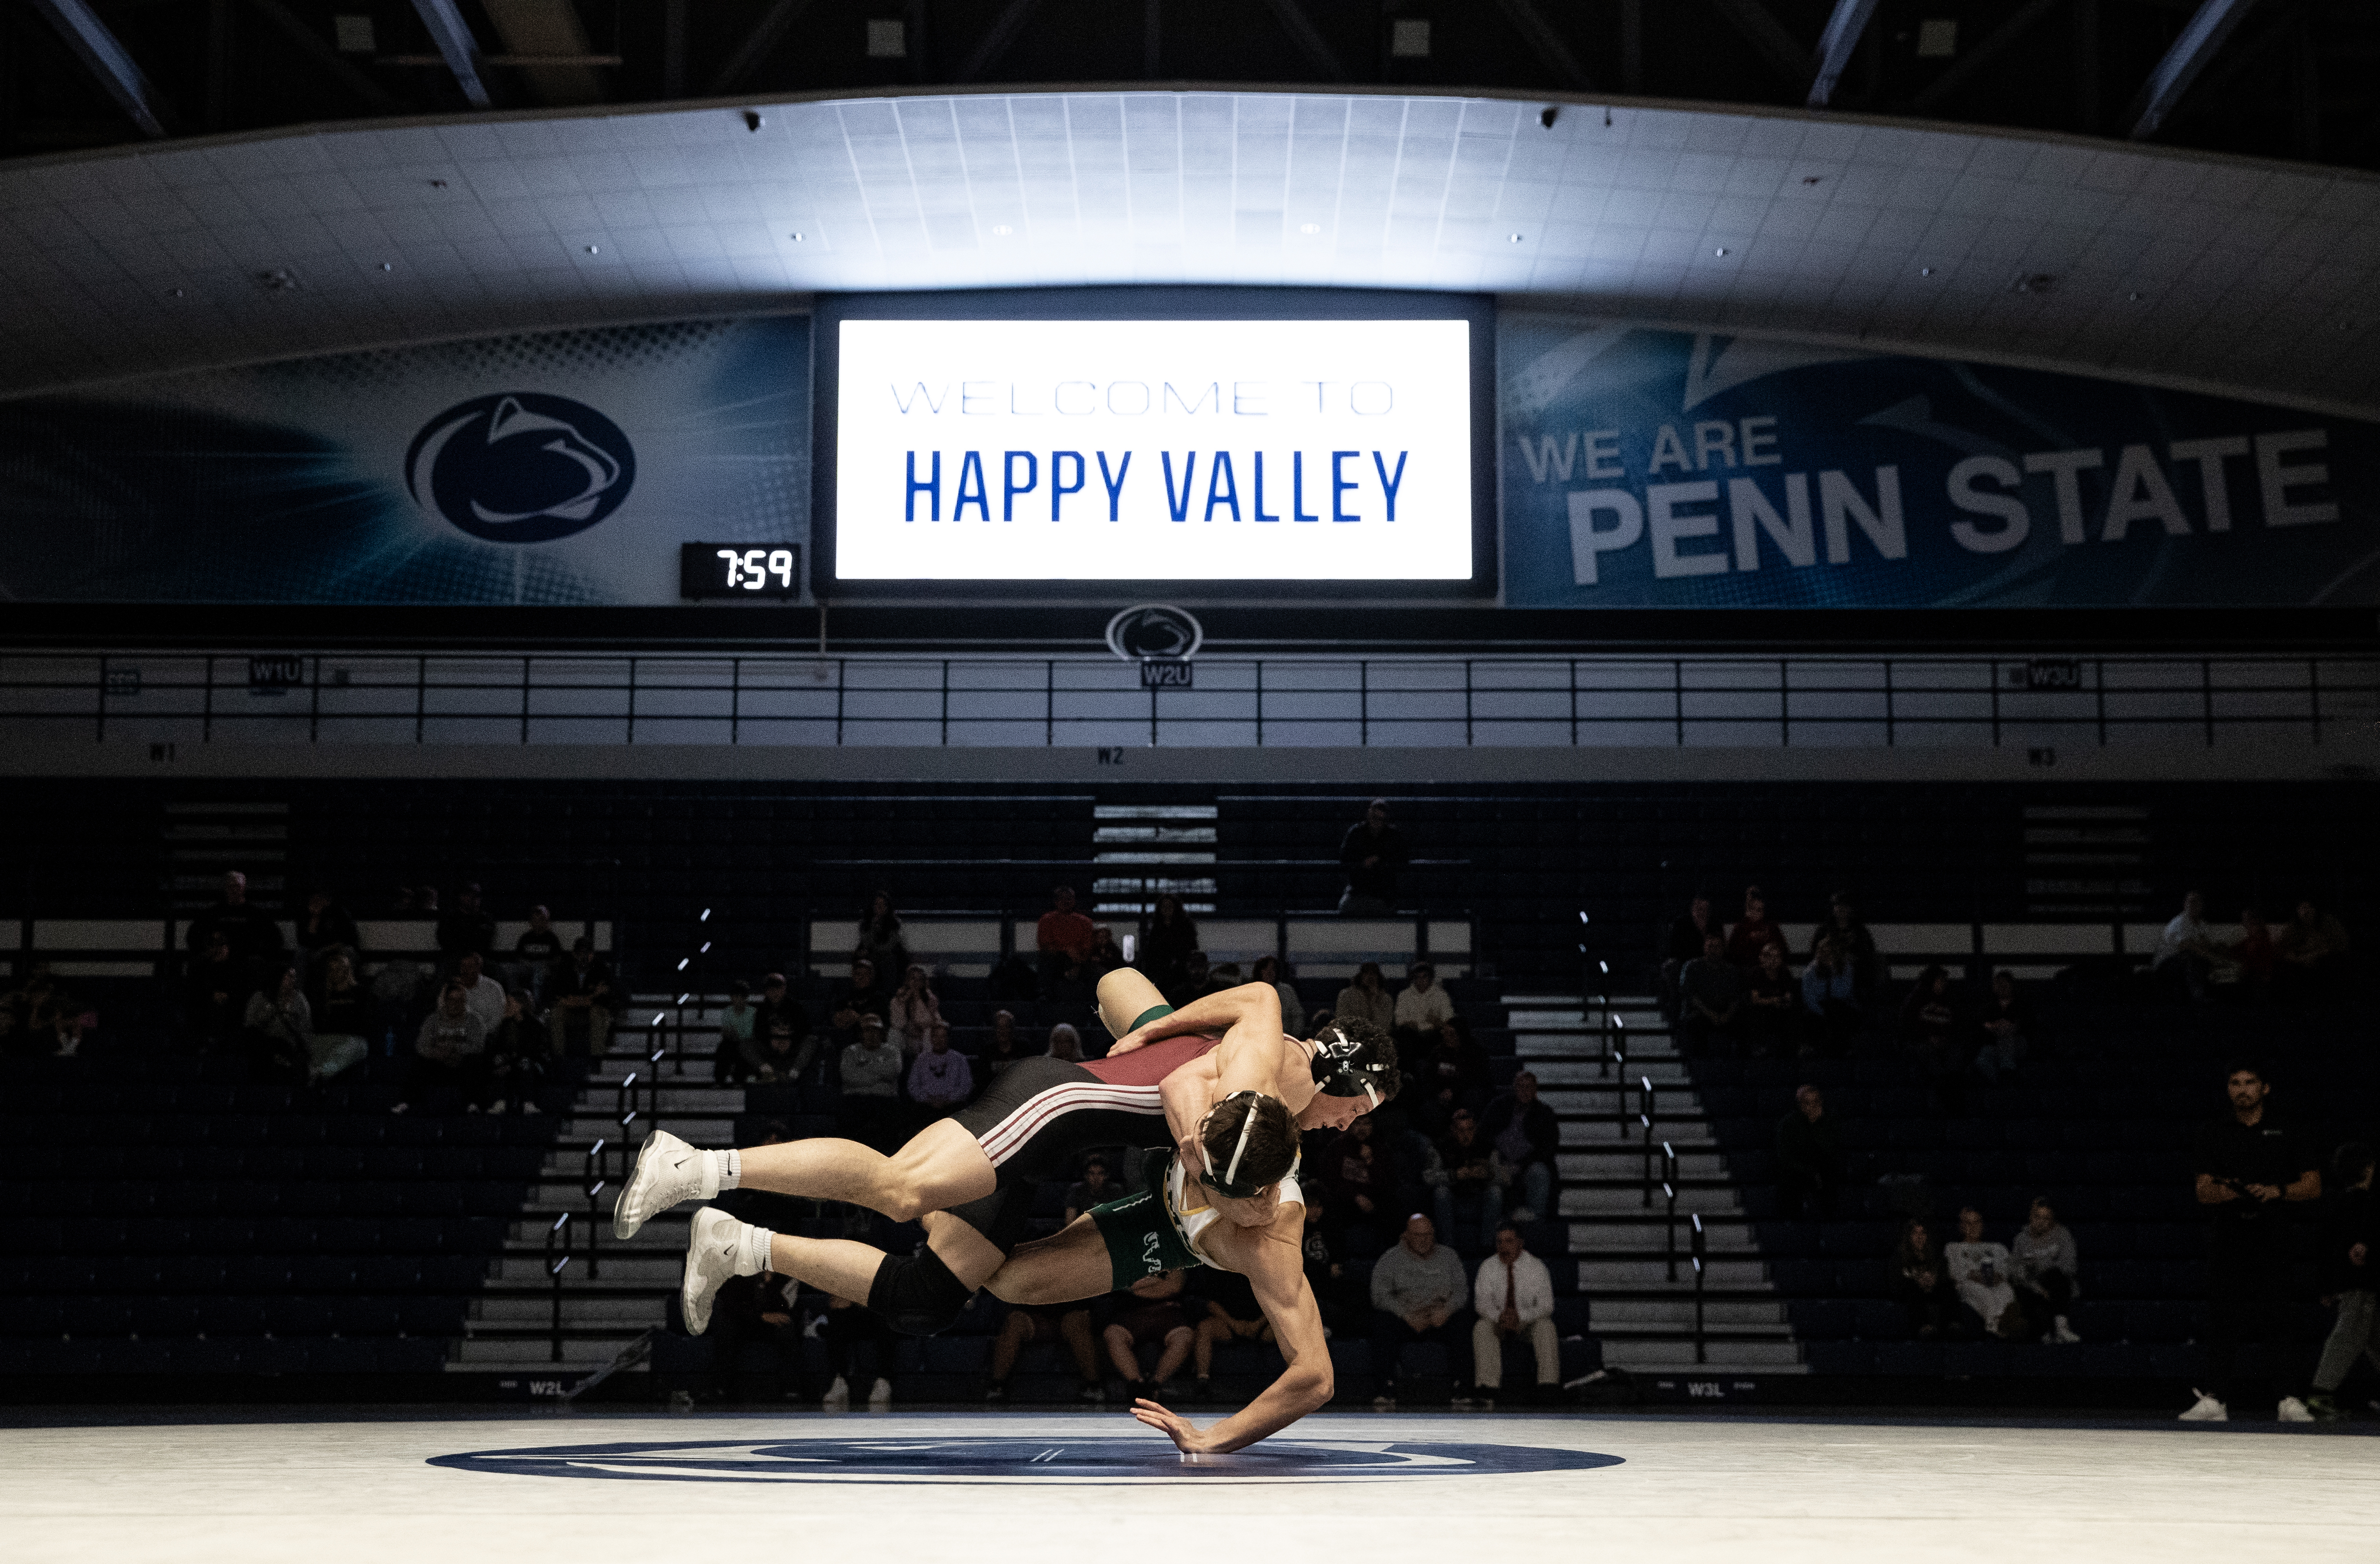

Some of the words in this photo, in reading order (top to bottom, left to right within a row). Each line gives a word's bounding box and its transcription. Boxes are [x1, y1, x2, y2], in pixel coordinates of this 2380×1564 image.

[891, 381, 1268, 415] WELCOME
[1300, 381, 1393, 415] TO
[1520, 430, 1625, 484] WE
[1649, 415, 1783, 474] ARE
[905, 451, 1132, 522] HAPPY
[1160, 451, 1408, 522] VALLEY
[1567, 464, 1908, 586] PENN
[1946, 428, 2341, 554] STATE
[717, 550, 793, 589] 7:59
[1142, 663, 1190, 685] W2U
[1098, 747, 1124, 764] W2
[529, 1380, 566, 1396] W2L
